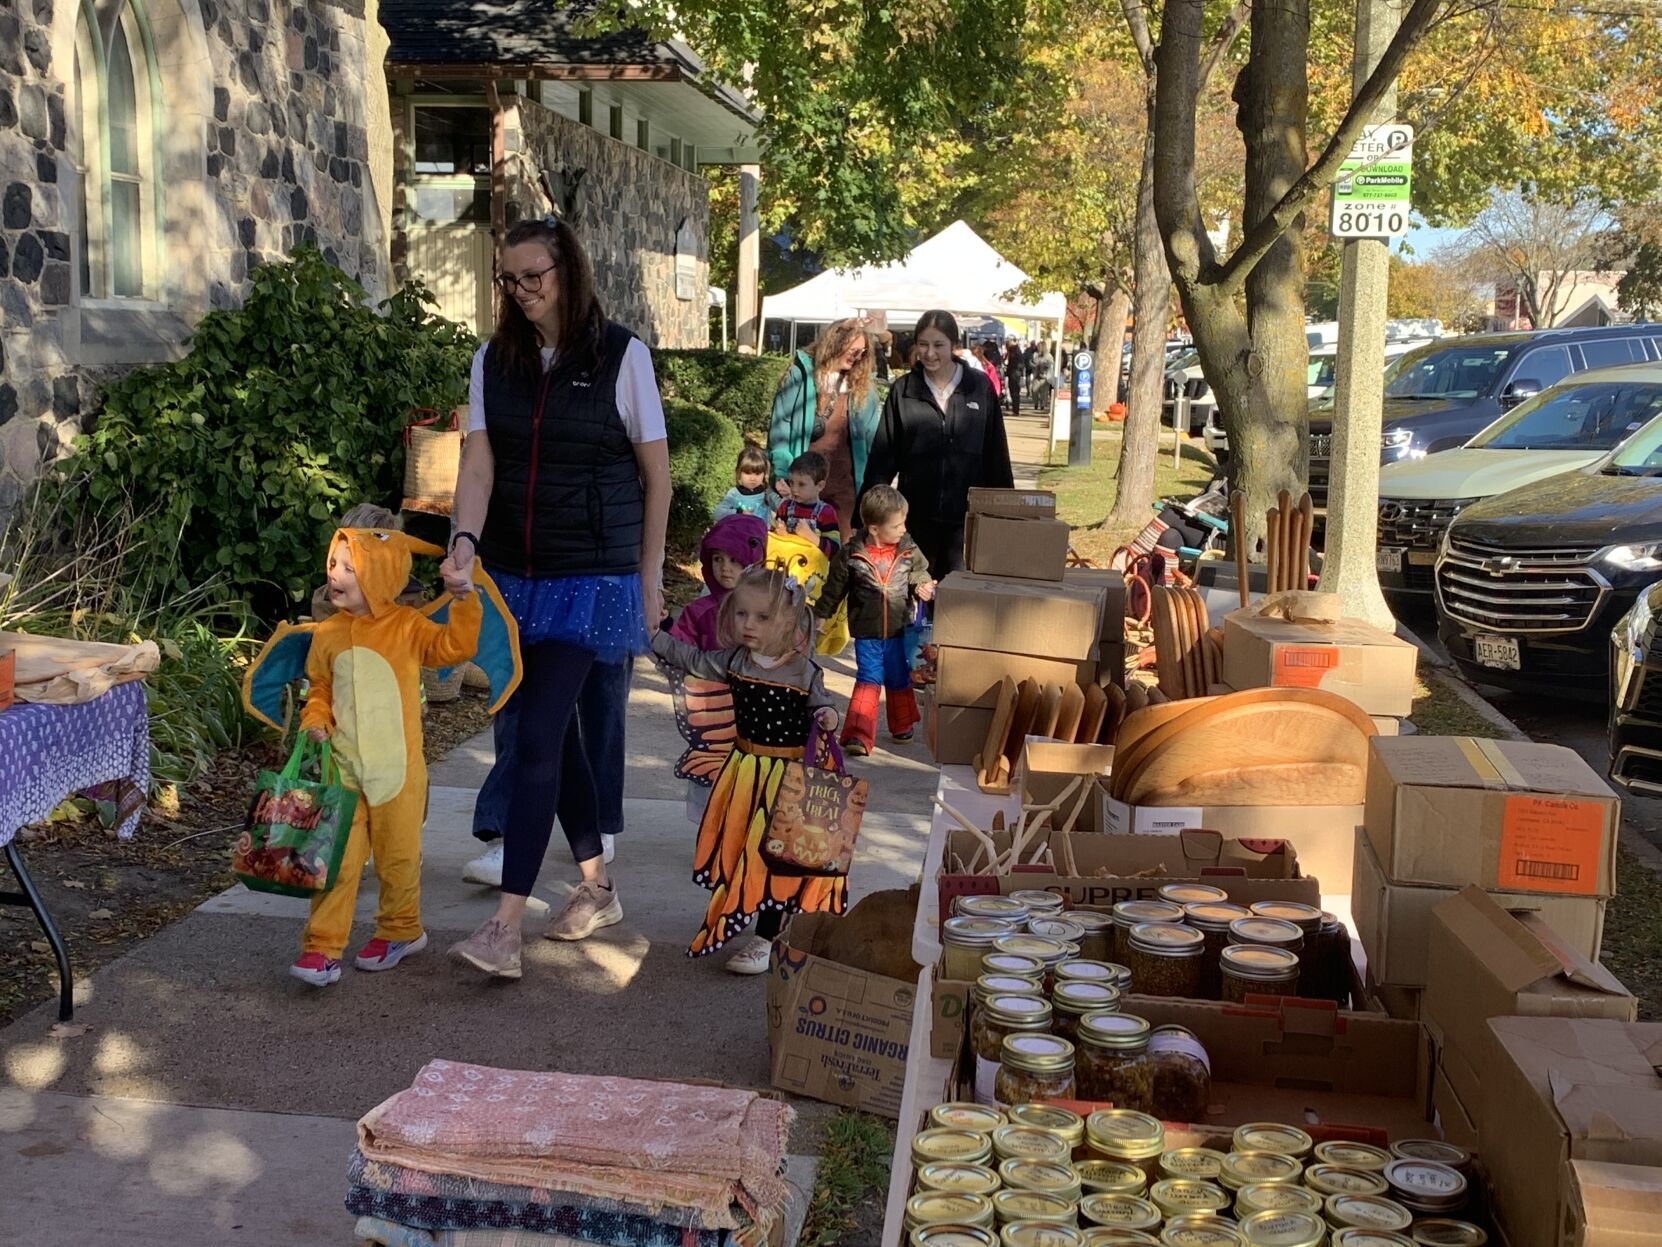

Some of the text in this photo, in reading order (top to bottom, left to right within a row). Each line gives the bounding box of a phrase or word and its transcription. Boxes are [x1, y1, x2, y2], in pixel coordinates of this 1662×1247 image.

[1351, 143, 1385, 152] ETER
[1339, 212, 1403, 232] 8010
[809, 785, 840, 804] TRICK
[796, 1017, 850, 1045] CITRUS
[853, 1033, 909, 1061] RGANIC
[821, 1053, 881, 1082] TerraFresh
